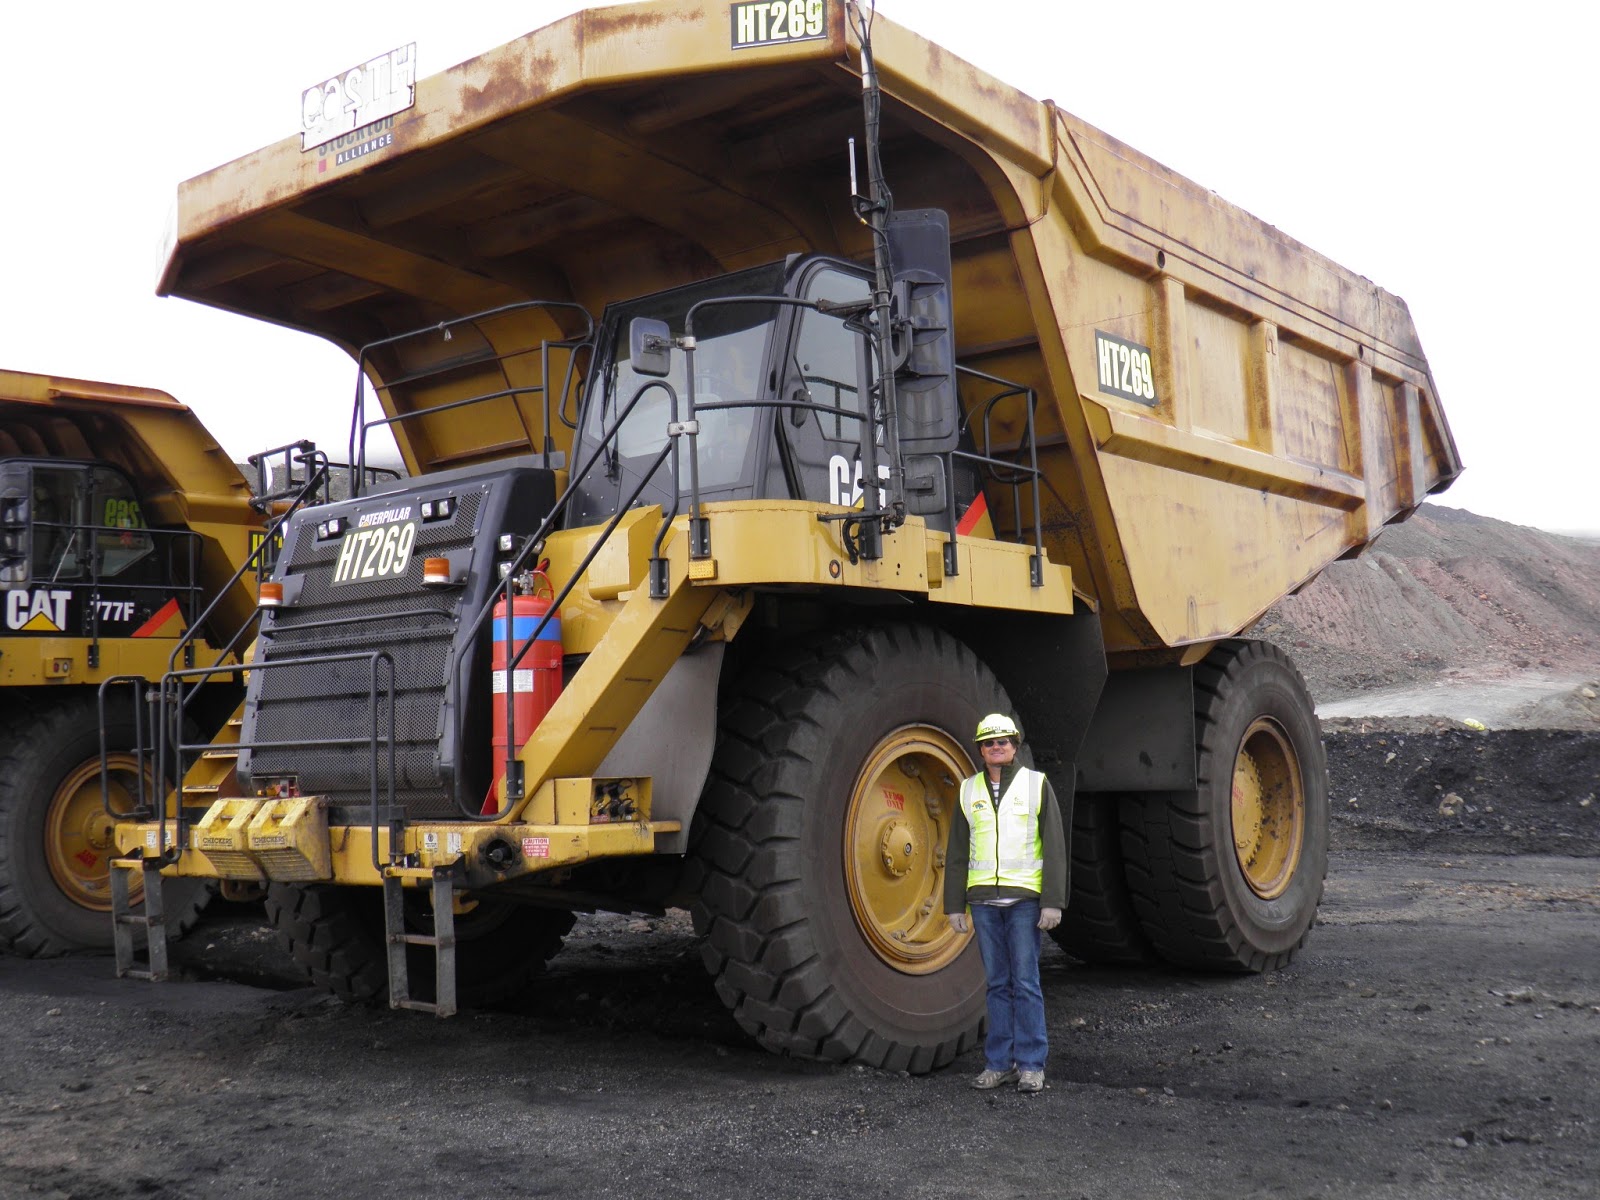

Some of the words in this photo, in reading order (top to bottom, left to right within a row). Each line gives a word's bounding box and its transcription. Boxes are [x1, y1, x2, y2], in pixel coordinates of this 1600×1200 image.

[737, 0, 823, 44] HT269
[337, 134, 392, 164] ALLIANCE
[1098, 337, 1155, 399] HT269
[358, 506, 411, 528] CATERPILLAR
[334, 522, 415, 583] HT269
[7, 589, 72, 631] CAT
[202, 837, 233, 845] CHECKERS
